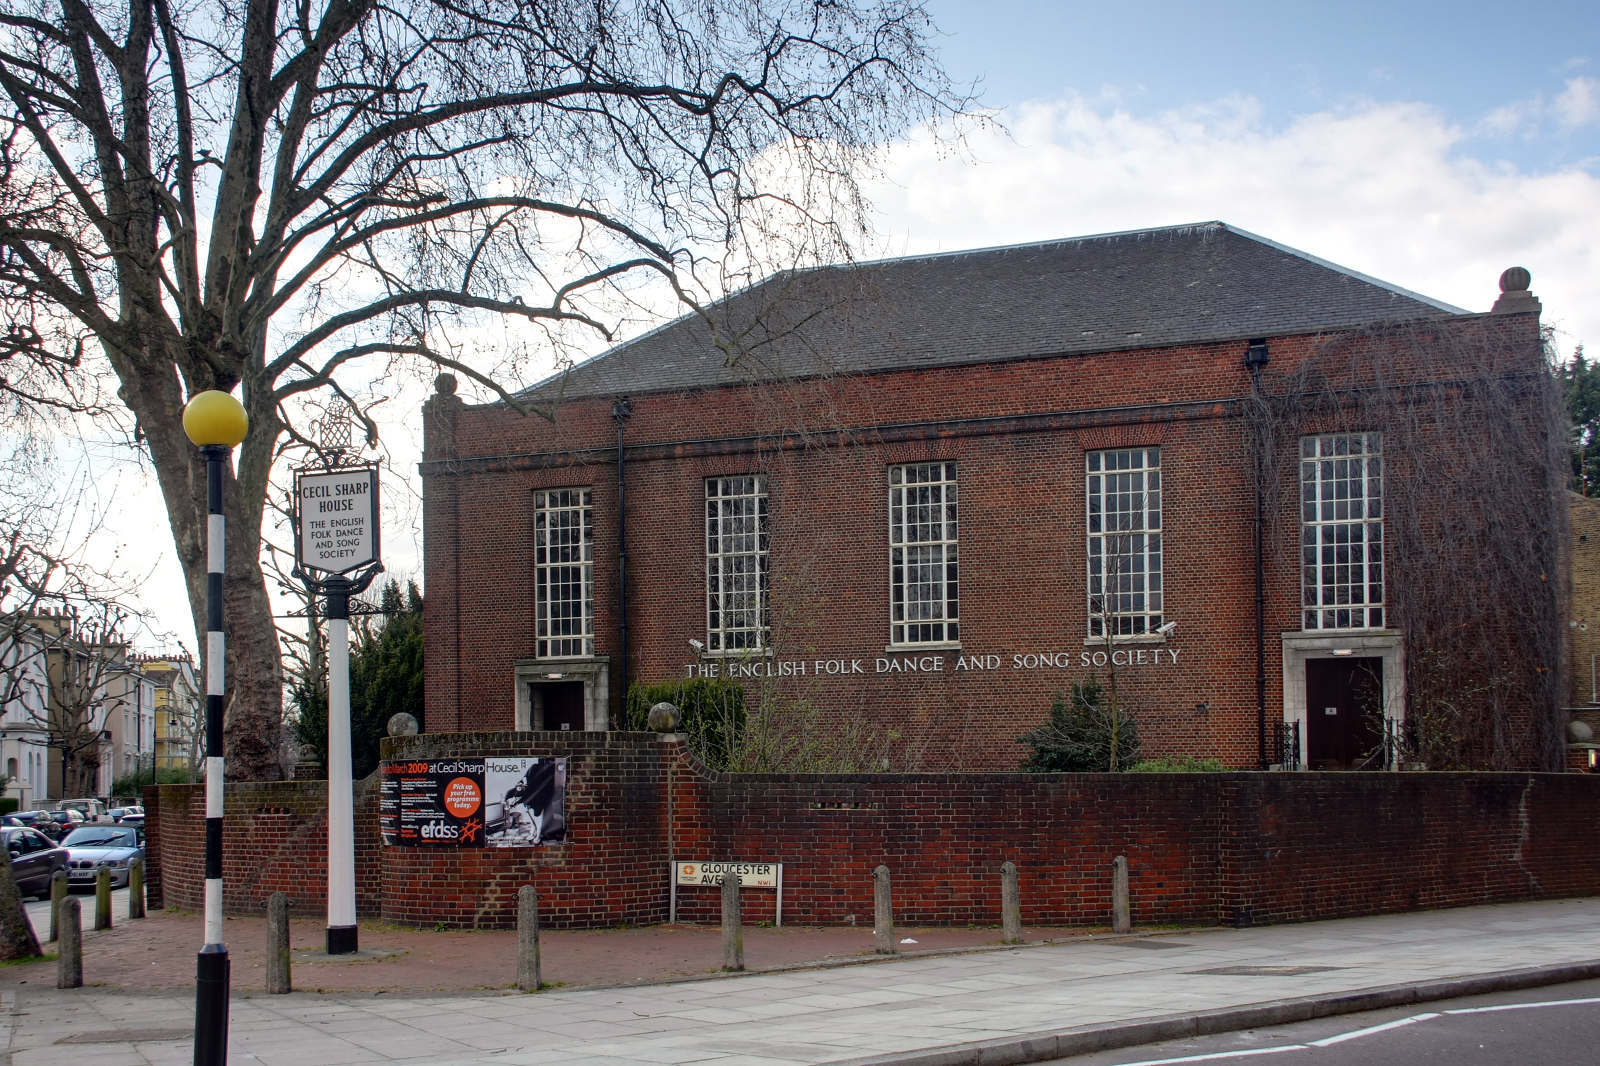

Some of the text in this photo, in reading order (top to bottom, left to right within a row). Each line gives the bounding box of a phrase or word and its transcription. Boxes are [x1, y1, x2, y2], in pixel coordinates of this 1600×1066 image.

[303, 482, 369, 499] CECIL SHARP
[319, 499, 353, 513] HOUSE
[310, 517, 364, 529] THE ENGLISH
[311, 527, 364, 540] FOLK DANCE
[315, 538, 360, 549] AND SONG
[319, 548, 356, 559] SOCIETY
[686, 663, 719, 679] THE
[815, 660, 864, 675] FOLK
[876, 656, 944, 673] DANCE
[955, 655, 1001, 671] AND
[1013, 653, 1070, 669] SONG
[1081, 649, 1182, 668] SOCIETY
[407, 762, 429, 774] 2009
[428, 764, 437, 774] at
[437, 762, 458, 774] Cecil
[458, 761, 485, 775] Sharp
[486, 761, 520, 774] House.
[421, 820, 459, 839] efdss
[701, 863, 770, 875] GLOUCESTER
[701, 874, 743, 886] AVE
